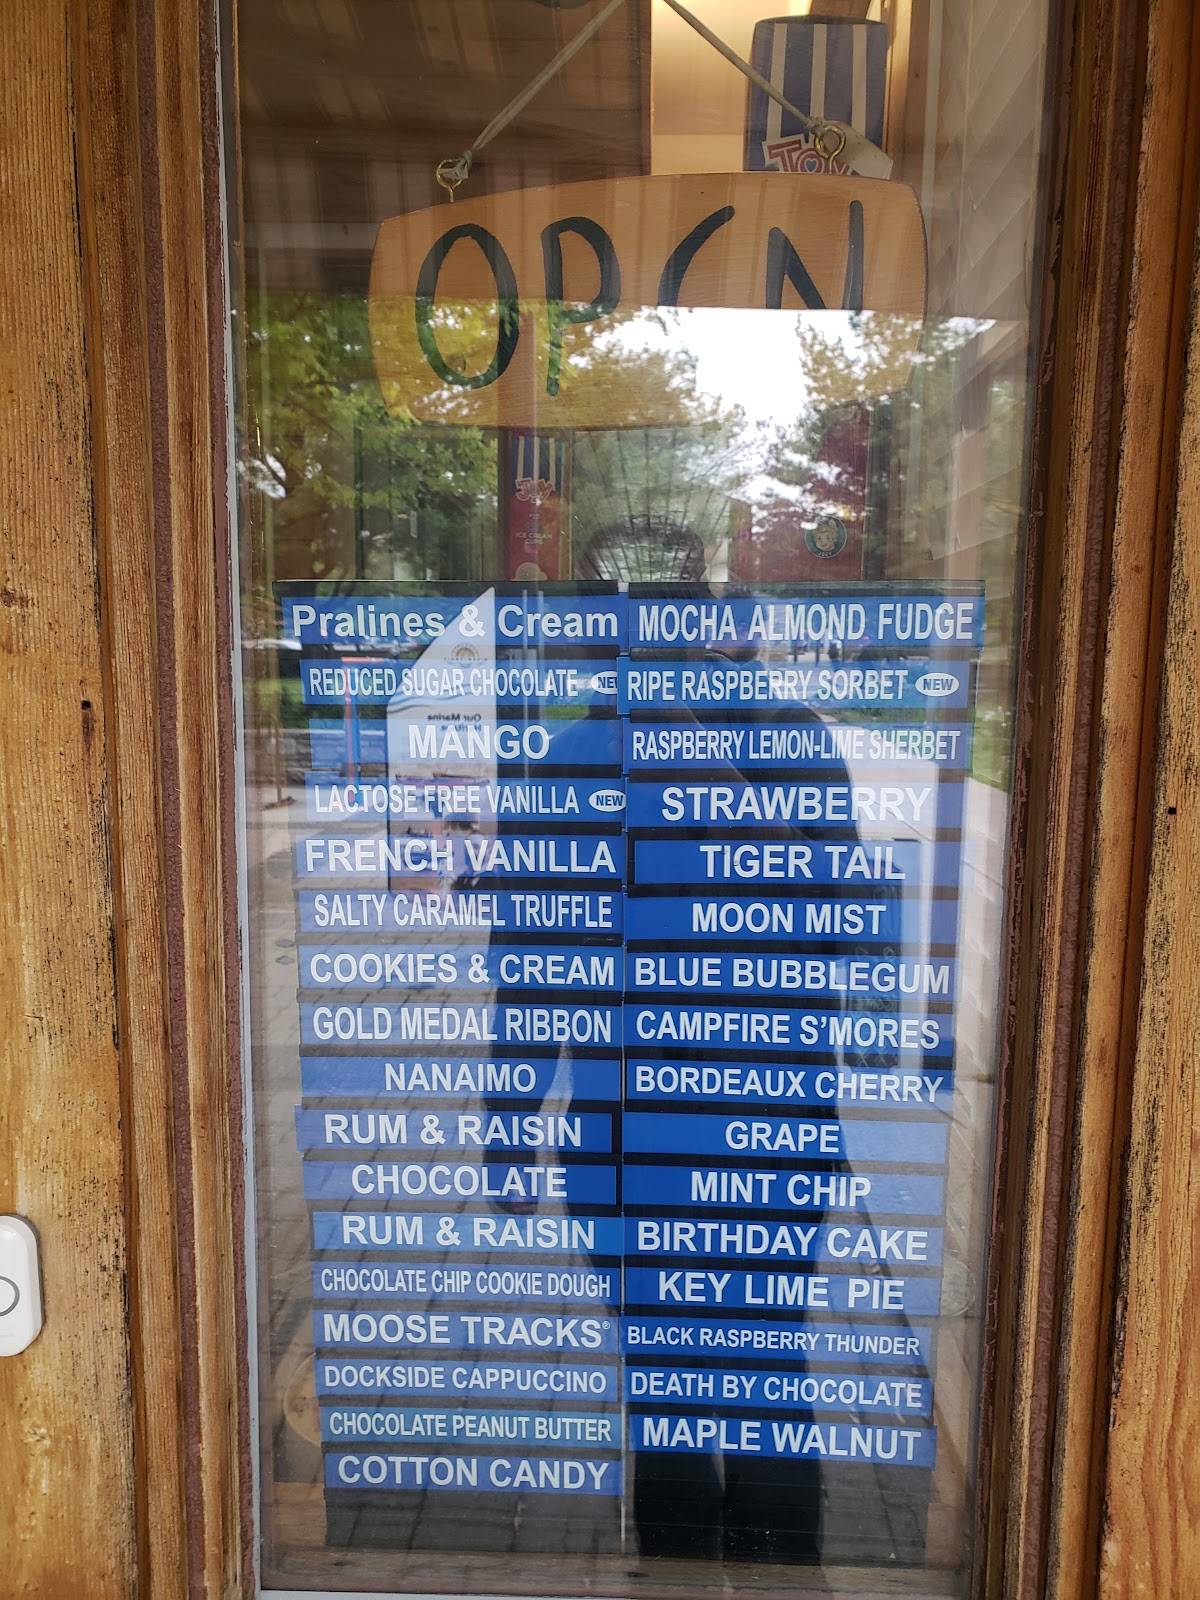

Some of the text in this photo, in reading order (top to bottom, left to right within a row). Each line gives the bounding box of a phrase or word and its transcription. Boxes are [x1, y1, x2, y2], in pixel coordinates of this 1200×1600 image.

[292, 604, 619, 638] Pralines & Cream
[637, 602, 974, 642] MOCHA ALMOND FUDGE
[309, 668, 397, 697] REDUCED
[401, 668, 466, 697] SUGAR
[469, 668, 579, 698] CHOCOLATE
[627, 669, 954, 701] RIPE RASPBERRY SORBET NEW
[407, 725, 550, 760] MANGO
[633, 730, 960, 761] RASPBERRY LEMON-LIME SHERBET
[314, 784, 624, 815] LACTOSE FREE VANILLA NEW
[661, 786, 933, 822] STRAWBERRY
[305, 839, 617, 873] FRENCH VANILLA
[700, 844, 906, 880] TIGER TAIL
[314, 893, 613, 928] SALTY CARAMEL TRUFFLE
[692, 902, 887, 935] MOON MIST
[309, 953, 615, 986] COOKIES & CREAM
[635, 957, 950, 994] BLUE BUBBLEGUM
[313, 1006, 612, 1043] GOLD MEDAL RIBBON
[636, 1010, 790, 1044] CAMPFIRE
[384, 1063, 537, 1093] NANAIMO
[635, 1065, 944, 1103] BORDEAUX CHERRY
[324, 1114, 582, 1148] RUM & RAISIN
[725, 1121, 840, 1153] GRAPE
[351, 1164, 568, 1198] CHOCOLATE
[690, 1171, 872, 1207] MINT CHIP
[342, 1215, 595, 1250] RUM & RAISIN
[637, 1220, 929, 1261] BIRTHDAY CAKE
[320, 1268, 611, 1298] CHOCOLATE CHIP COOKIE DOUGH
[658, 1271, 905, 1310] KEY LIME PIE
[323, 1313, 450, 1344] MOOSE
[627, 1325, 921, 1356] BLACK RASPBERRY THUNDER
[324, 1365, 608, 1394] DOCKSIDE CAPPUCCINO
[630, 1371, 923, 1408] DEATH BY CHOCOLATE
[329, 1411, 612, 1443] CHOCOLATE PEANUT BUTTER
[642, 1417, 922, 1461] MAPLE WALNUT
[337, 1455, 610, 1491] COTTON CANDY
